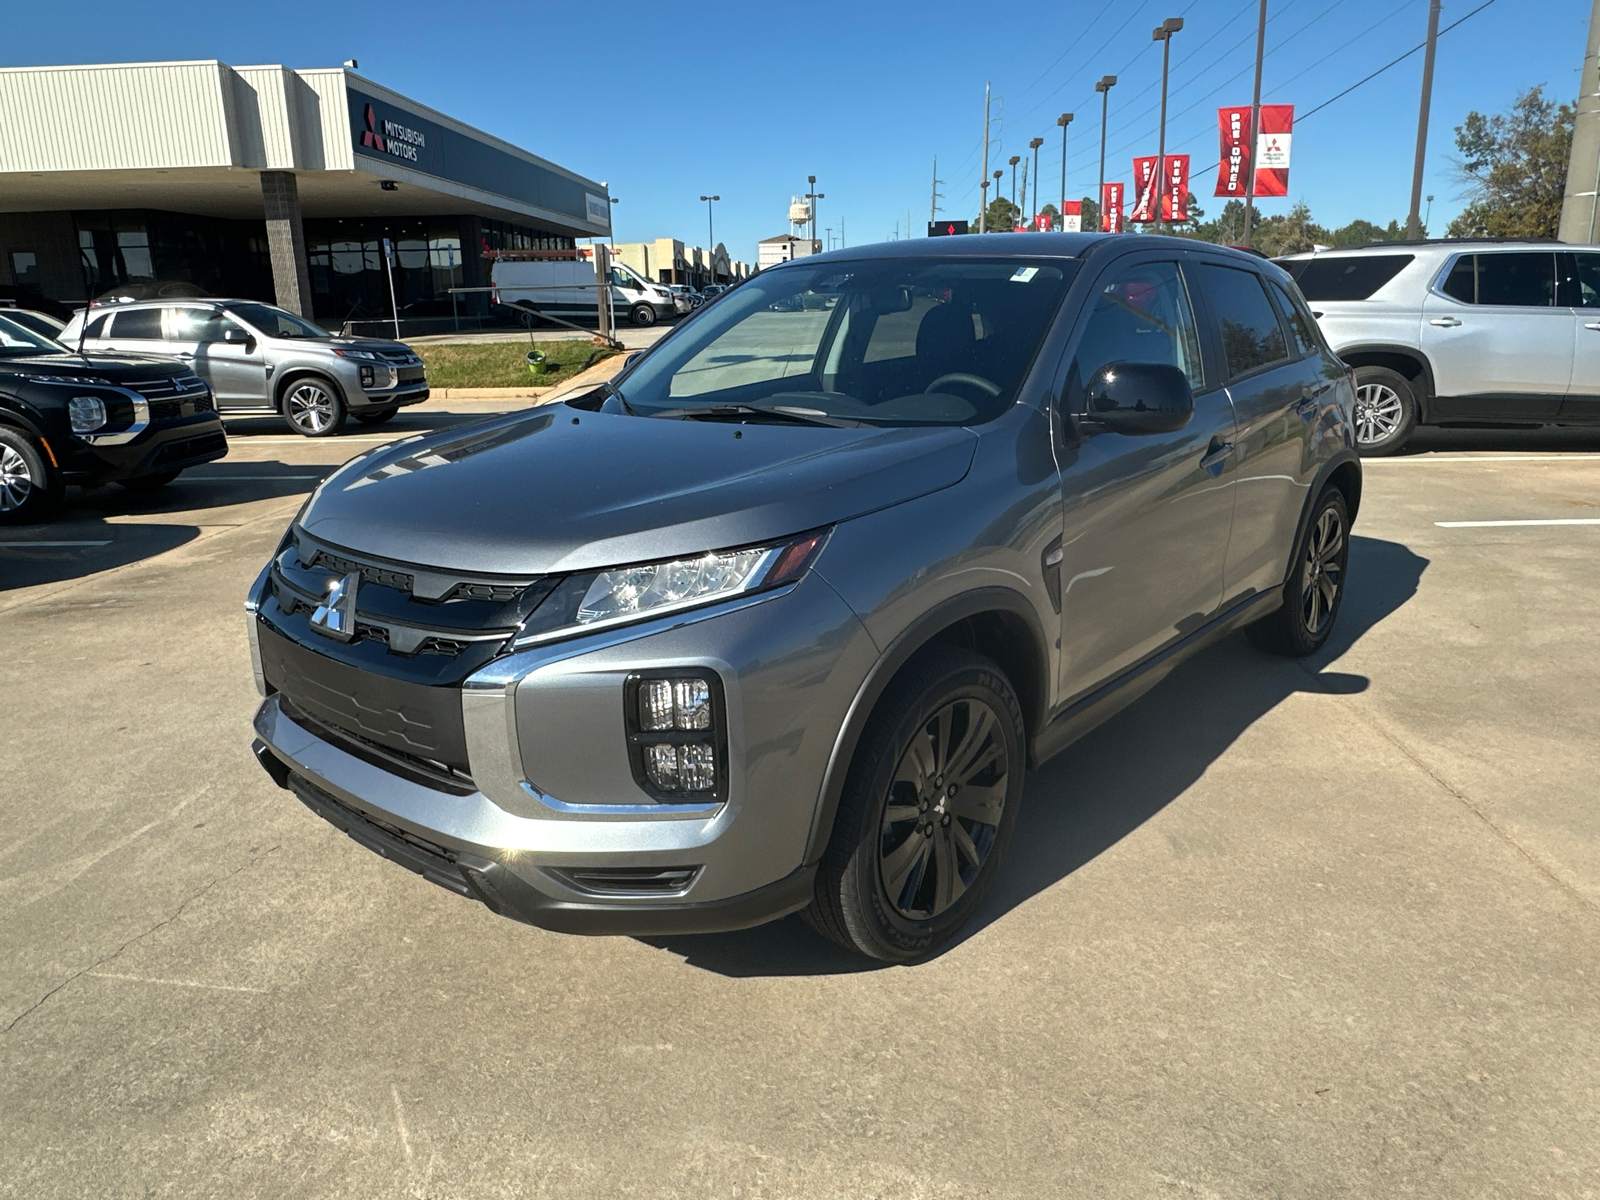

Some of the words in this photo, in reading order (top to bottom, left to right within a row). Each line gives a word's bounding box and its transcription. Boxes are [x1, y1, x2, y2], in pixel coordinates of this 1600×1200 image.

[385, 120, 425, 147] MITSUBISHI
[387, 139, 417, 161] MOTORS
[1228, 113, 1241, 190] PRE-OWNED
[1172, 160, 1181, 185] NEW
